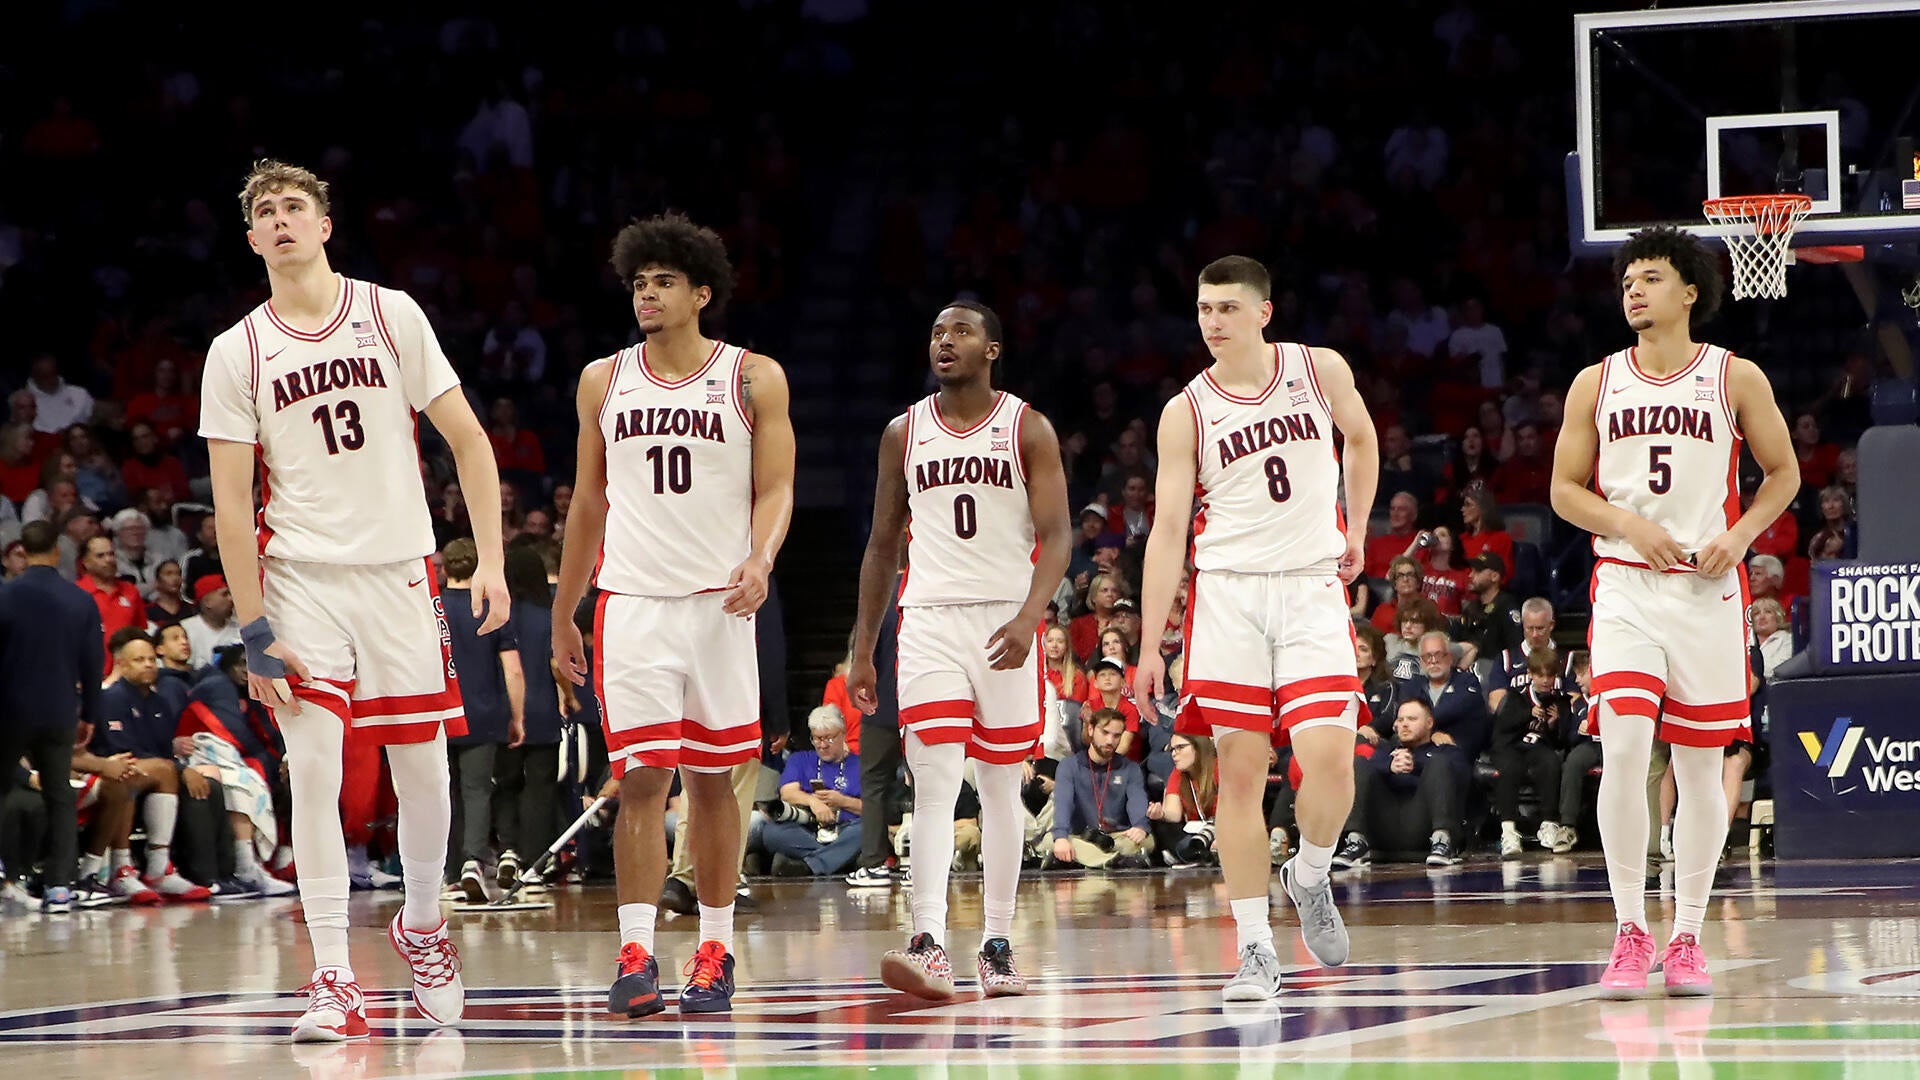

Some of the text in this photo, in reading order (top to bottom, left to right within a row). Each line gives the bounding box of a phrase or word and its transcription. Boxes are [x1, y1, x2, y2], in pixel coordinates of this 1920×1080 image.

[271, 357, 388, 413] ARIZONA
[311, 399, 365, 456] 13
[614, 407, 726, 443] ARIZONA
[1217, 413, 1321, 470] ARIZONA
[1608, 405, 1714, 443] ARIZONA
[646, 445, 692, 495] 10
[915, 456, 1014, 493] ARIZONA
[1264, 455, 1292, 503] 8
[1648, 445, 1672, 495] 5
[953, 493, 977, 540] 0
[1838, 564, 1907, 577] SHAMROCK
[1831, 575, 1920, 623] ROCK
[1864, 736, 1920, 763] Van
